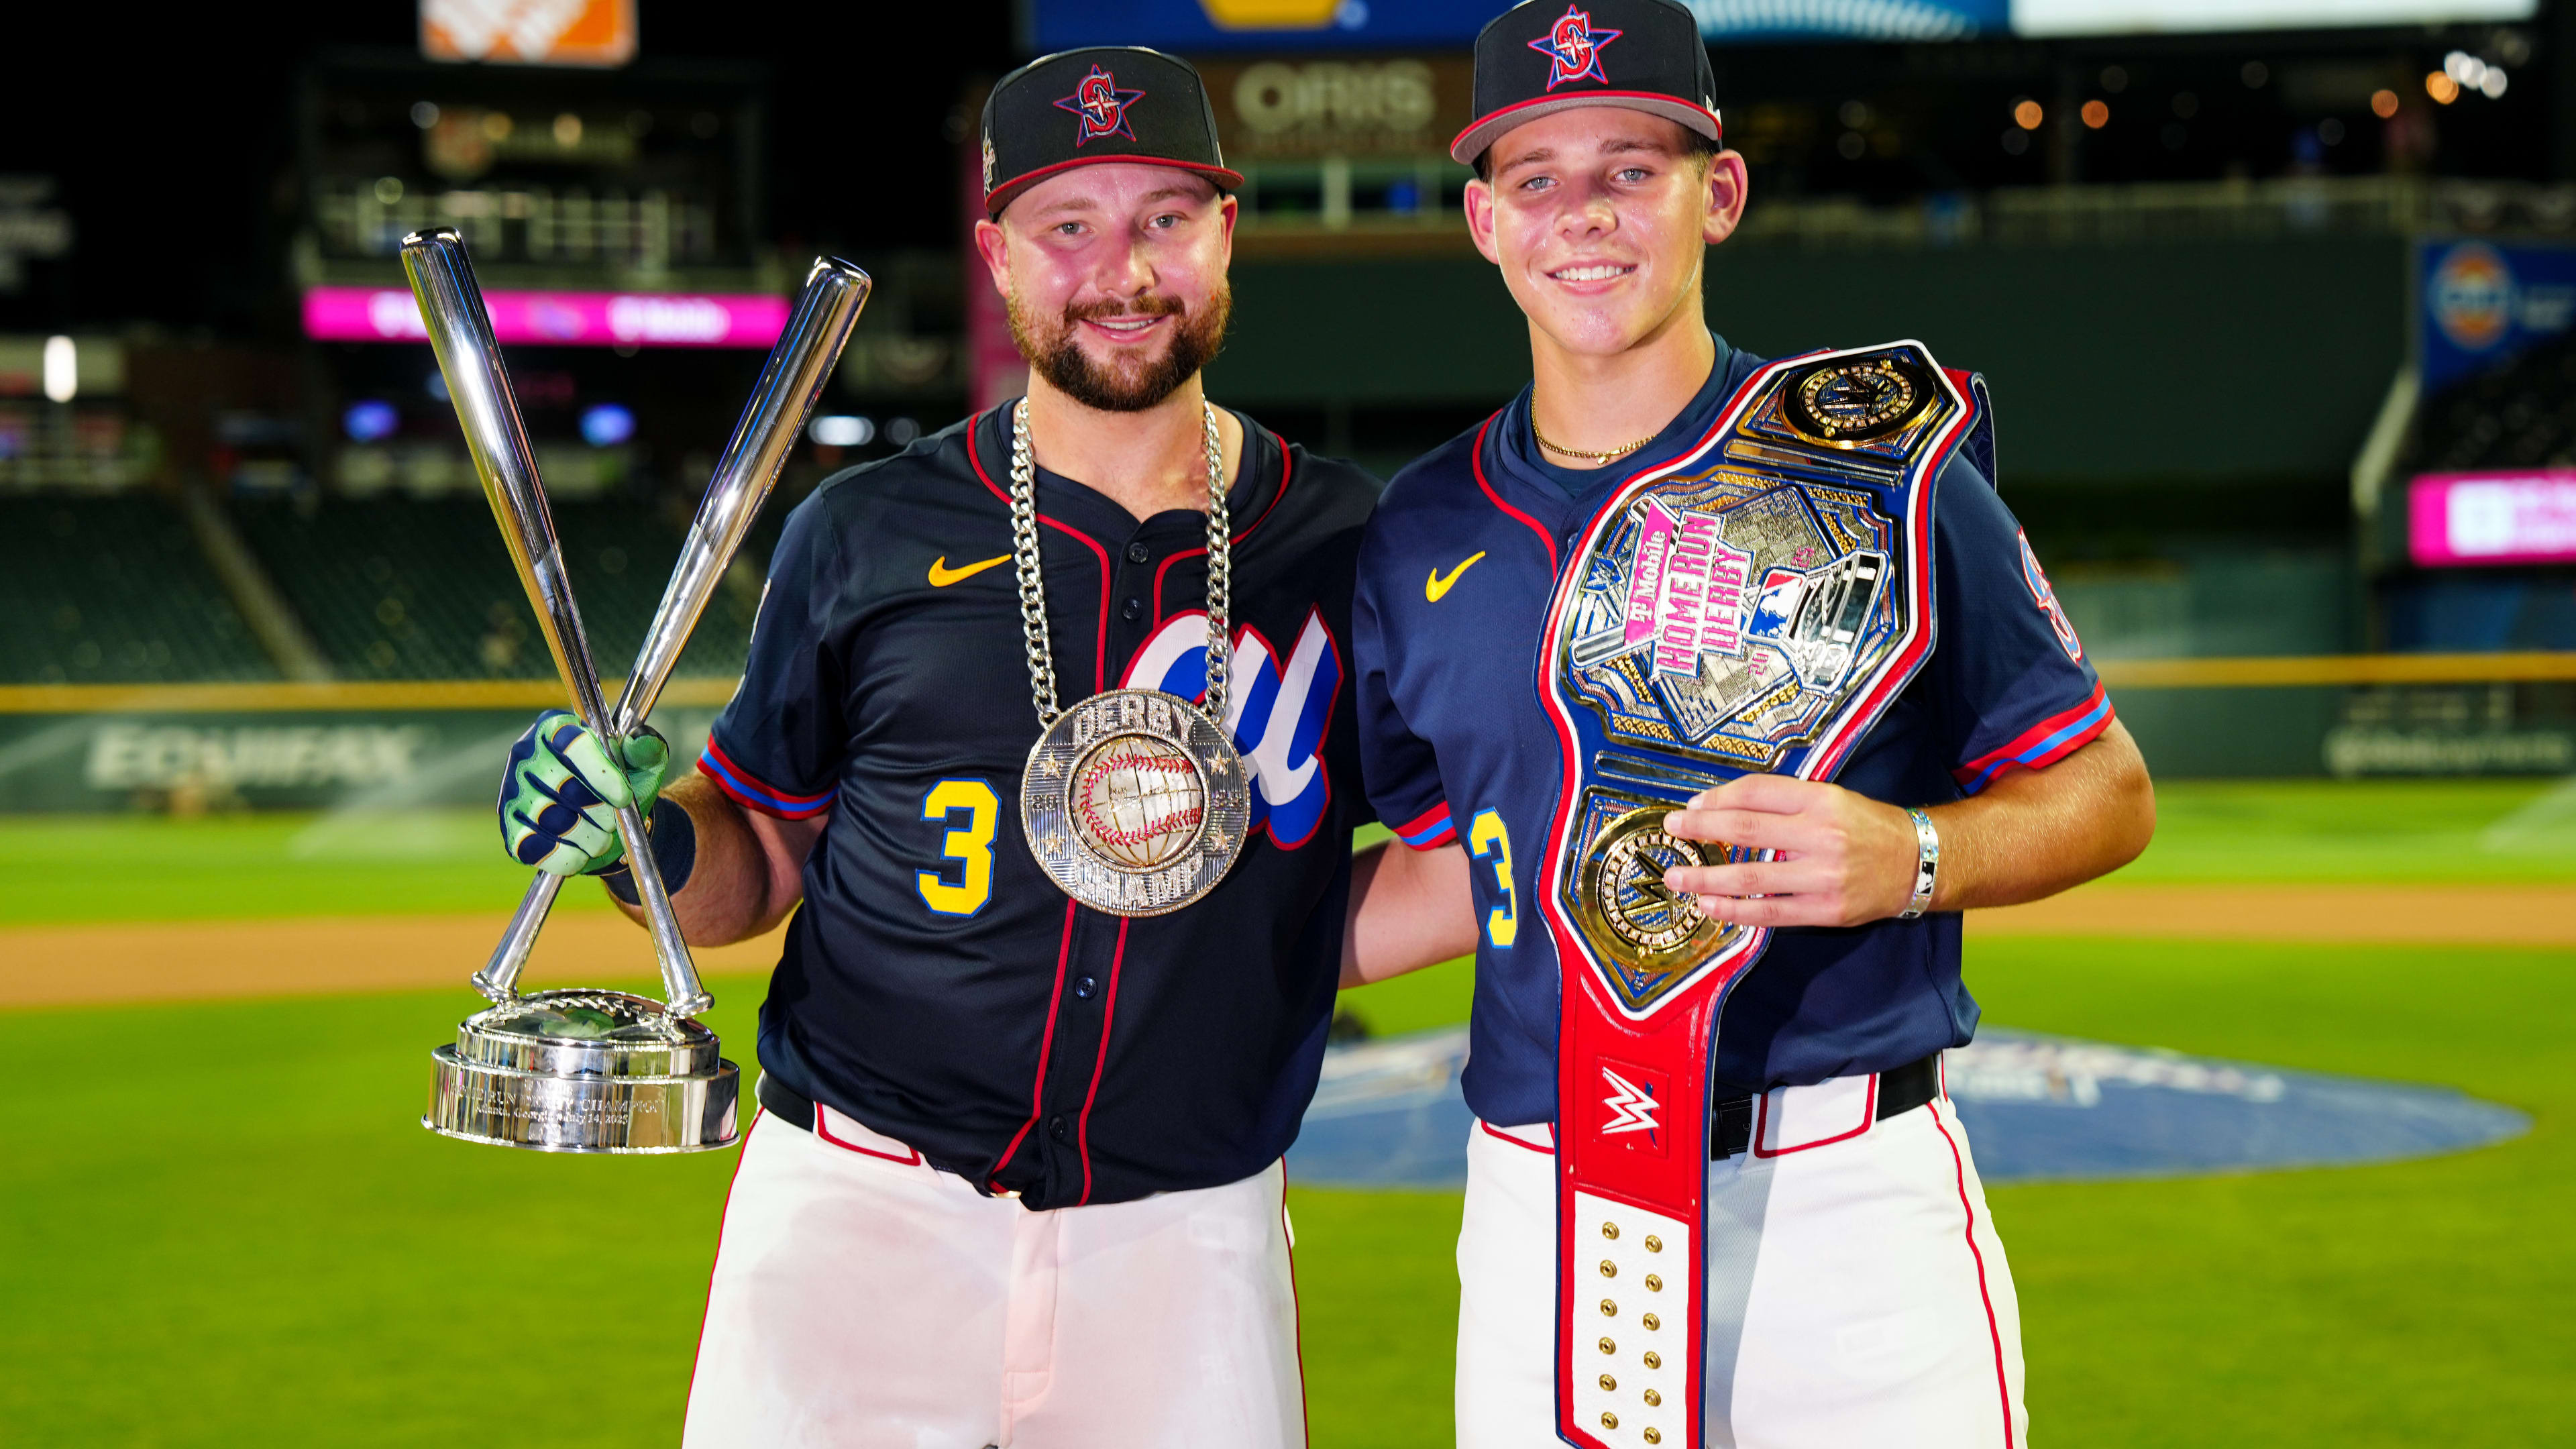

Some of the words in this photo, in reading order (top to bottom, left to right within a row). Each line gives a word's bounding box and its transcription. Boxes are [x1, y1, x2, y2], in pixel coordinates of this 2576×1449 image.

[1632, 531, 1667, 602] Mobile
[1790, 545, 1815, 568] 25
[1701, 547, 1746, 649] DERBY
[1748, 652, 1770, 676] 20
[1075, 694, 1195, 749] DERBY
[916, 777, 1002, 918] 3
[1075, 851, 1205, 908] CHAMP
[1467, 806, 1518, 949] 3
[488, 1091, 517, 1106] RUN
[580, 1098, 665, 1114] CHAMPION
[604, 1114, 629, 1126] 2025
